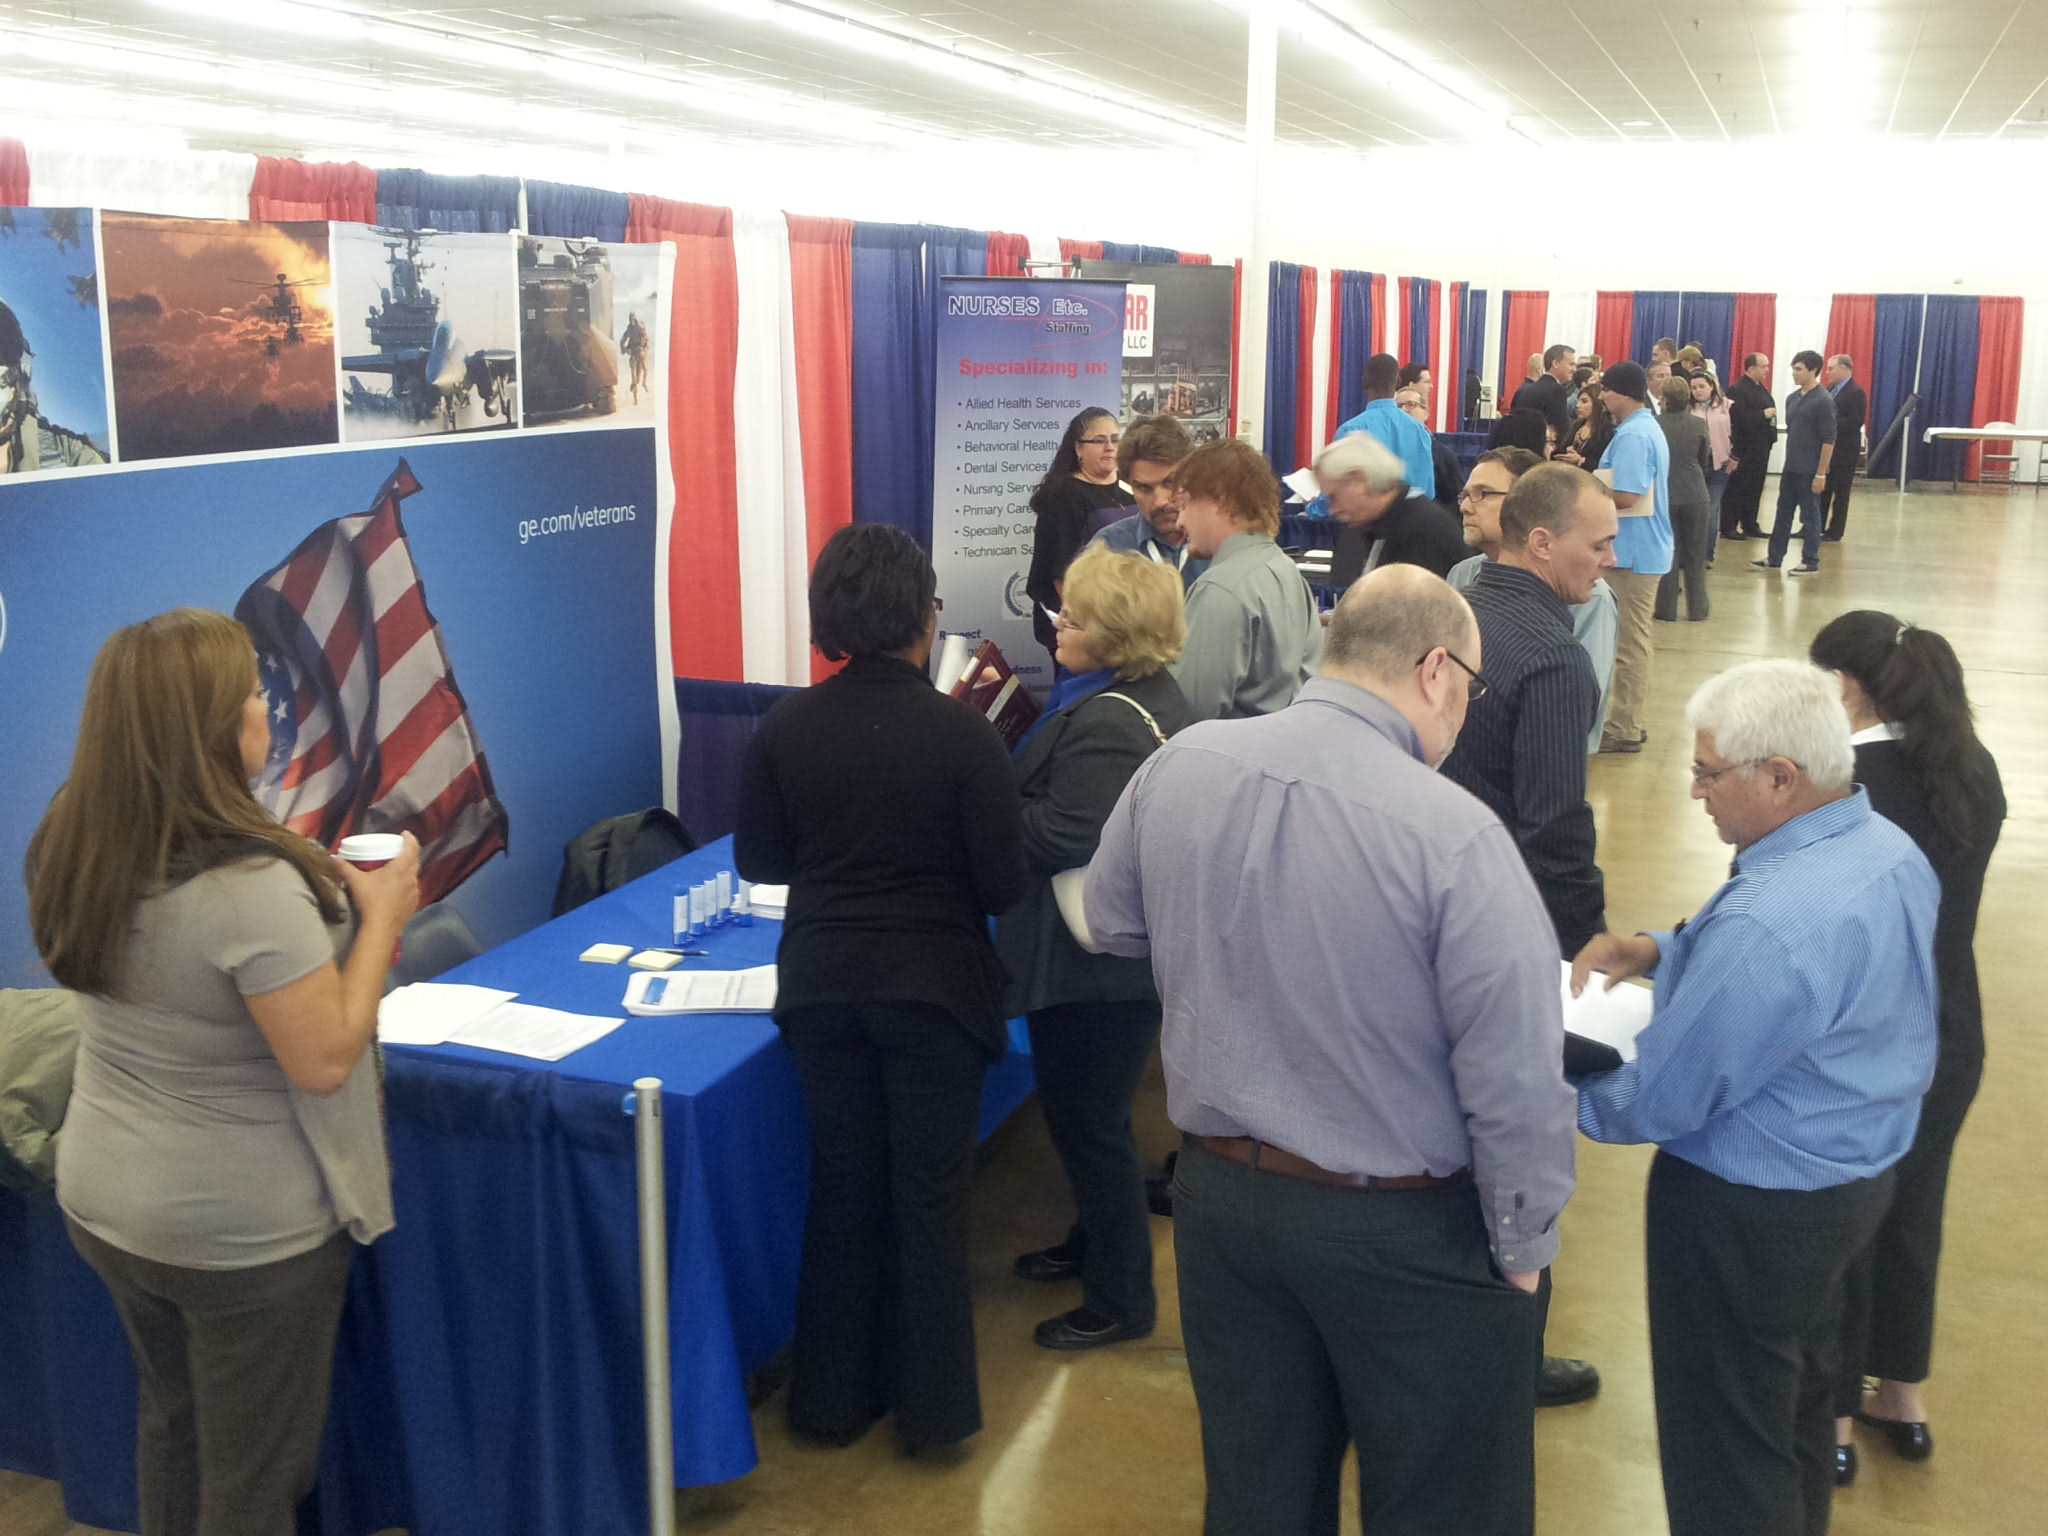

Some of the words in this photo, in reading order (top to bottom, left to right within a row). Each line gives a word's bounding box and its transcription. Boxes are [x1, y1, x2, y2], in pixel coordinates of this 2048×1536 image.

[947, 296, 1040, 316] NURSES
[1052, 298, 1089, 316] Etc.
[1046, 321, 1091, 335] Staffing
[1127, 335, 1147, 349] LLC
[959, 358, 1079, 379] Specializing
[1085, 359, 1108, 375] in:
[965, 398, 994, 410] Allied
[997, 397, 1032, 409] Health
[1035, 397, 1082, 408] Services
[964, 419, 1010, 432] Ancillary
[1012, 418, 1060, 430] Services
[964, 440, 1019, 453] Behavioral
[1023, 439, 1059, 451] Health
[964, 462, 998, 474] Dental
[1000, 460, 1048, 473] Services
[963, 483, 1003, 496] Nursing
[962, 504, 1003, 517] Primary
[1006, 503, 1033, 515] Care
[518, 504, 637, 545] ge.com/veterans
[962, 524, 1010, 538] Specialty
[962, 545, 1017, 558] Technician
